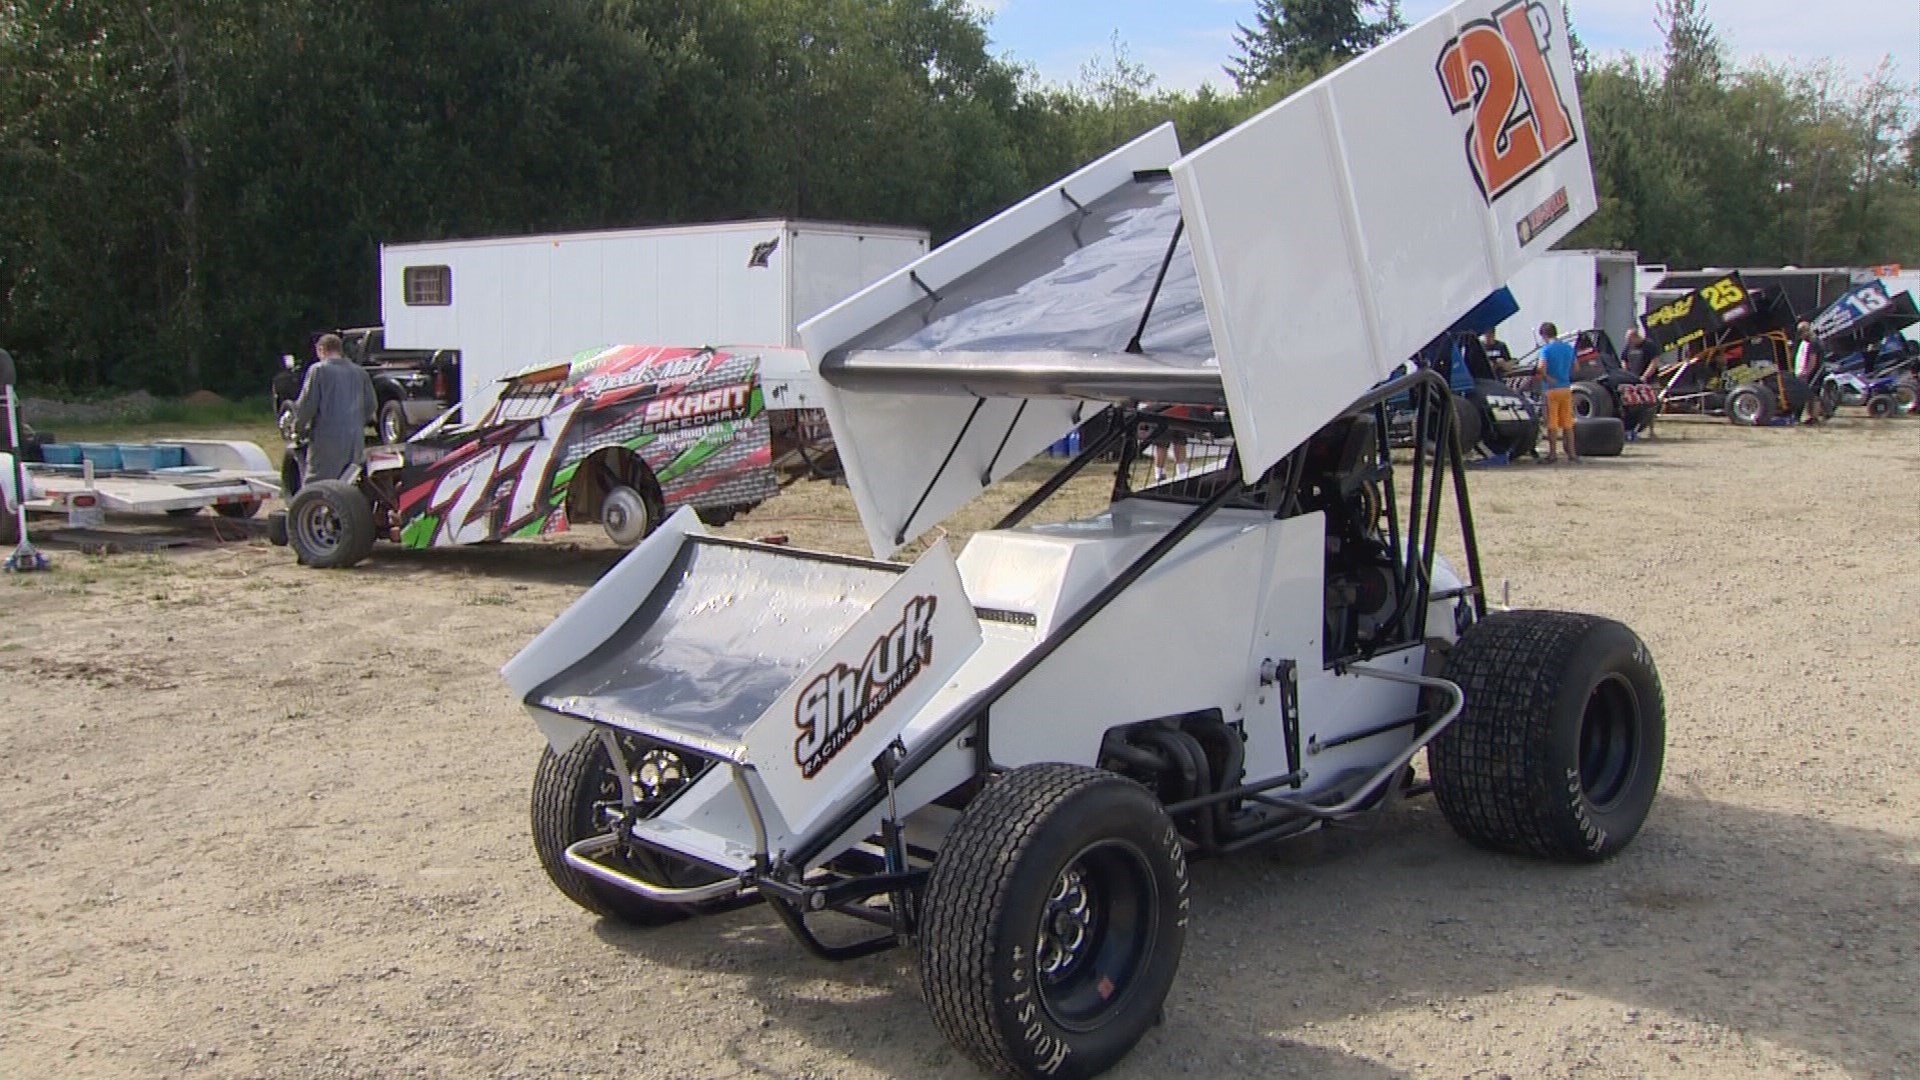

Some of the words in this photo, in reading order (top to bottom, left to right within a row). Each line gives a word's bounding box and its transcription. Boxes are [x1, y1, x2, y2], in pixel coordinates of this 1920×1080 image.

[1700, 278, 1743, 311] 25
[1846, 287, 1887, 315] 13
[644, 384, 751, 424] SKAGIT
[641, 408, 746, 434] SPEEDWAY
[731, 418, 753, 434] WA
[803, 717, 860, 777] RACING
[862, 656, 921, 721] ENGINES
